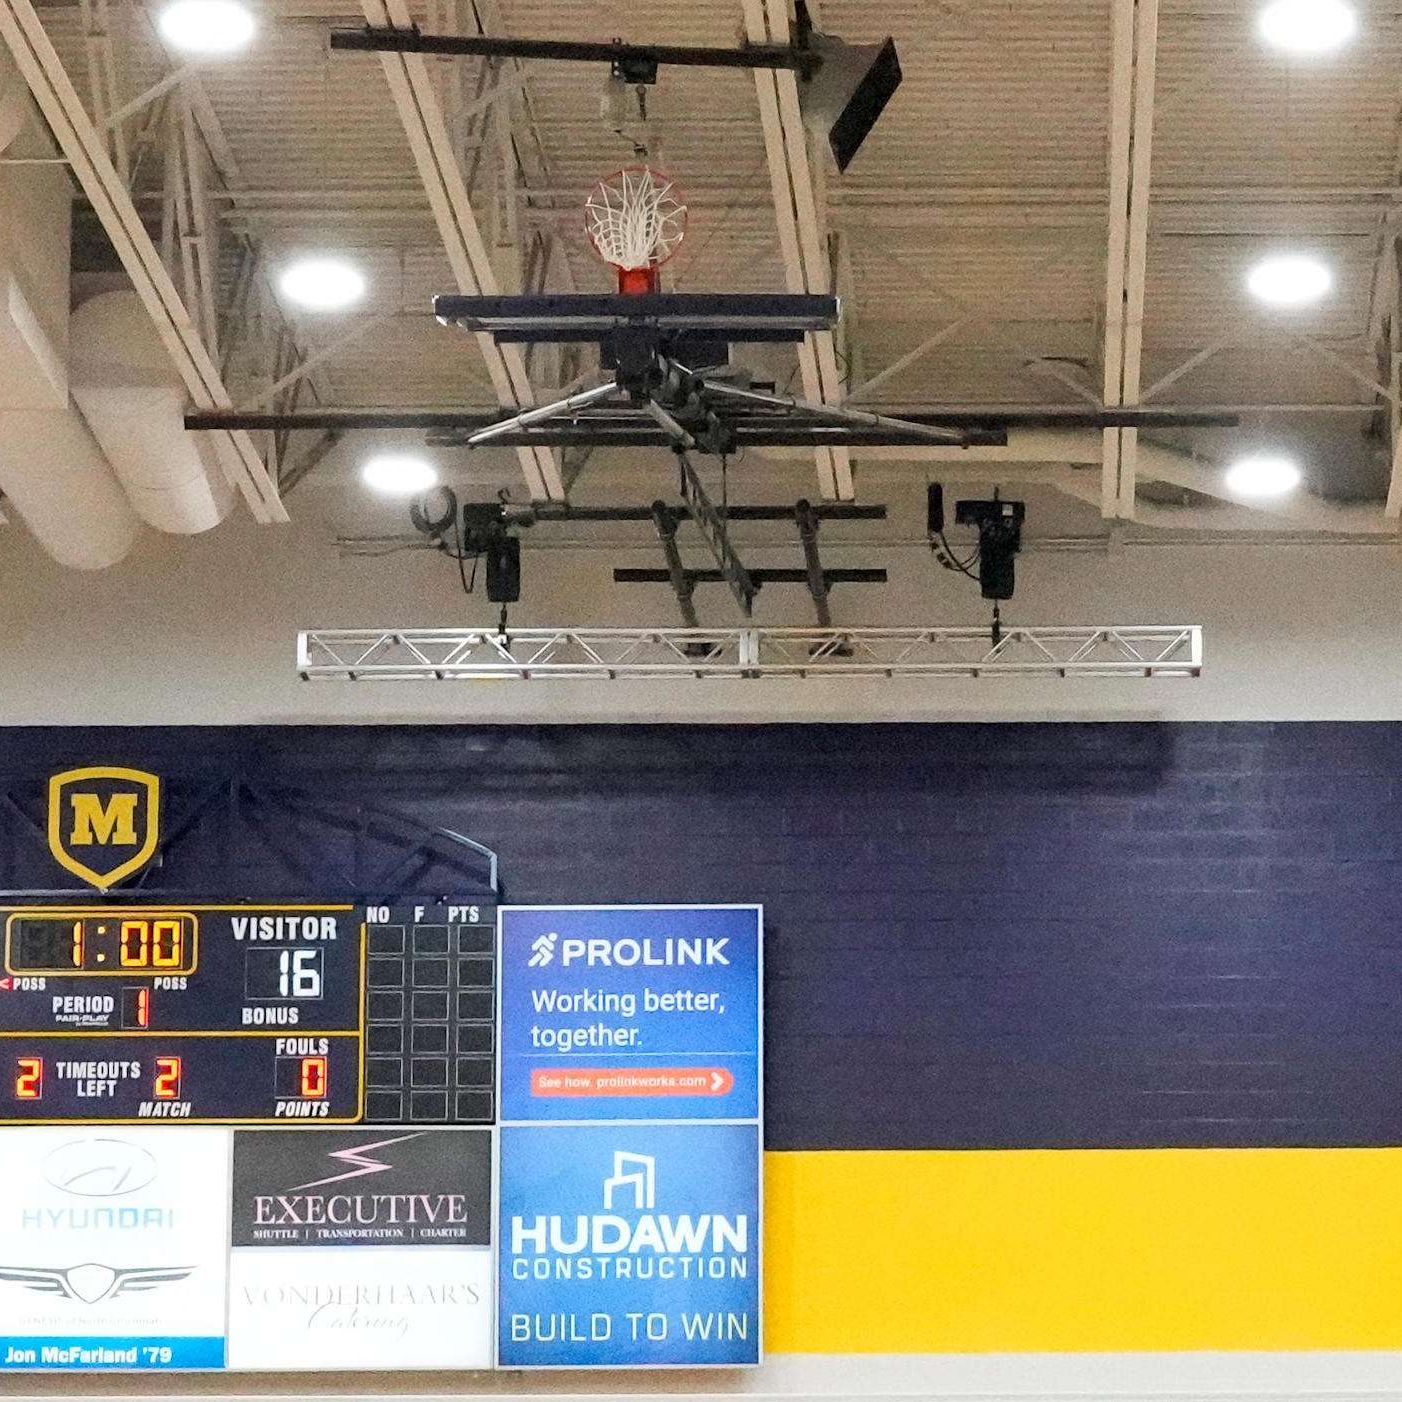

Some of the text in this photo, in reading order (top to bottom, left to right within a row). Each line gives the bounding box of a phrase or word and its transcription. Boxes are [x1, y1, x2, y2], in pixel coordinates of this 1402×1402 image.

[70, 793, 137, 845] M
[366, 906, 480, 923] NO F PTS
[231, 916, 337, 941] VISITOR
[72, 920, 182, 968] 1:00
[562, 938, 730, 967] PROLINK
[13, 977, 46, 991] POSS
[154, 976, 187, 990] POSS
[279, 950, 321, 996] 16
[52, 996, 114, 1014] PERIOD
[137, 988, 149, 1027] 1
[531, 988, 726, 1017] Working better,
[242, 1006, 299, 1025] BONUS
[275, 1037, 329, 1055] FOULS
[531, 1024, 643, 1049] together.
[16, 1059, 41, 1098] 2
[56, 1061, 141, 1080] TIMEOUTS
[156, 1058, 180, 1097] 2
[301, 1058, 325, 1097] 0
[76, 1080, 116, 1097] LEFT
[539, 1077, 560, 1088] See
[596, 1076, 706, 1090] prolinkworks.com
[139, 1101, 191, 1118] MATCH
[275, 1101, 330, 1117] POINTS
[22, 1208, 174, 1230] HYUNDAI
[254, 1195, 468, 1224] EXECUTIVE
[254, 1228, 467, 1239] SHUTTLE TRANSPORTATION CHARTER
[511, 1215, 748, 1254] HUDAWN
[512, 1257, 747, 1280] CONSTRUCTION
[244, 1284, 480, 1305] VONDERHAAR'S
[511, 1313, 748, 1342] BUILD TO WIN
[5, 1346, 173, 1363] Jon McFarland '79
